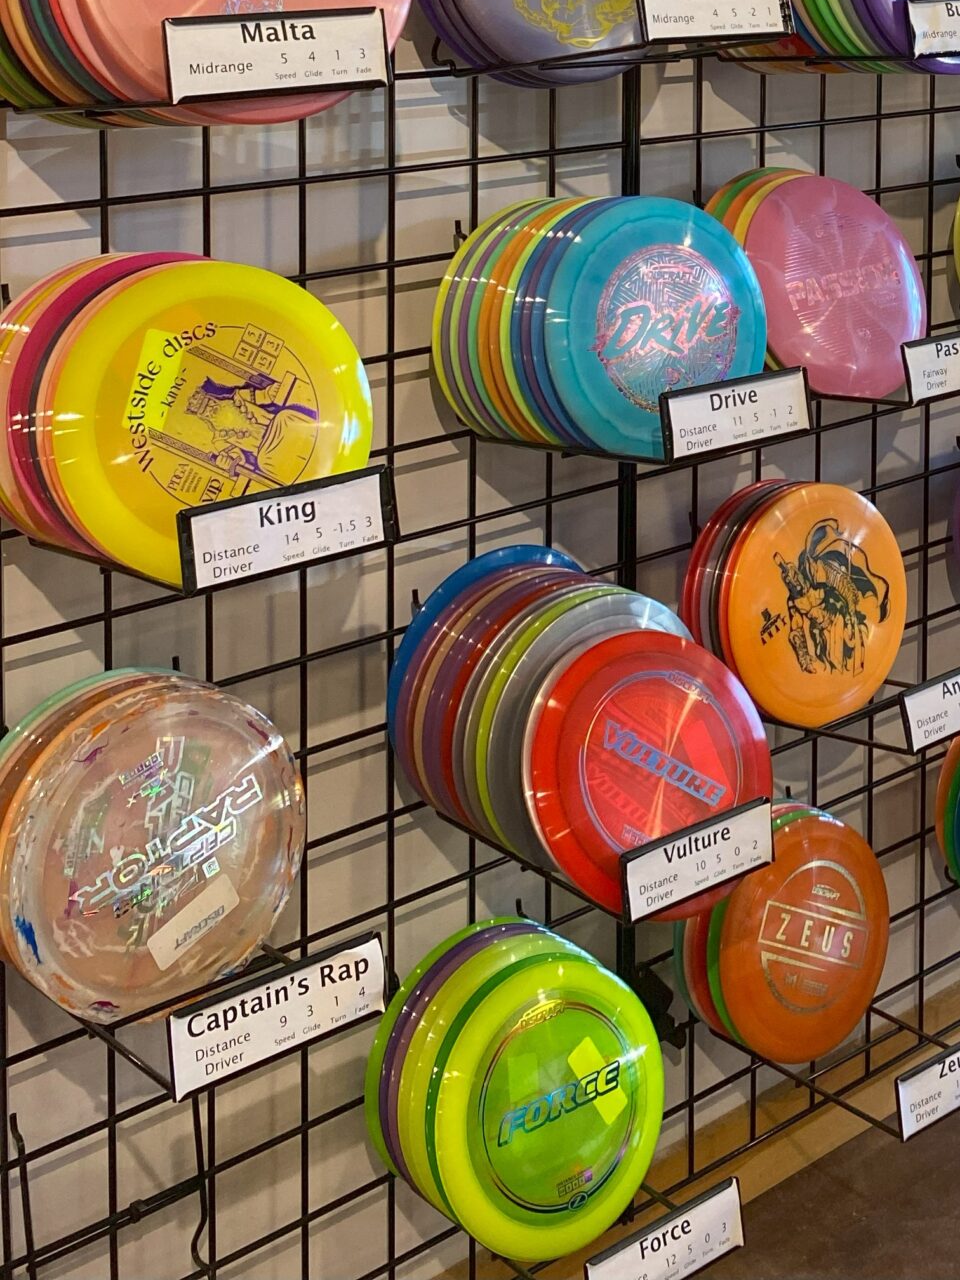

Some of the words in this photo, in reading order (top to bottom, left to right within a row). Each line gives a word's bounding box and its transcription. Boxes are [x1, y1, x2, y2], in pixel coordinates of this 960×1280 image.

[653, 15, 694, 25] Midrange
[240, 20, 316, 44] Malta
[189, 61, 253, 75] Midrange
[275, 71, 296, 81] Speed
[600, 297, 733, 360] DRIVE
[923, 367, 948, 379] Fairway
[927, 380, 947, 391] Driver
[128, 360, 162, 473] westside
[162, 322, 217, 359] discs
[710, 389, 758, 411] Drive
[679, 423, 717, 439] Distance
[686, 438, 713, 450] Driver
[202, 478, 224, 503] VIP
[259, 500, 316, 528] King
[285, 532, 299, 544] 14
[334, 521, 356, 534] -1.5
[203, 543, 260, 564] Distance
[283, 551, 305, 561] Speed
[213, 561, 253, 579] Driver
[917, 710, 948, 728] Distance
[924, 724, 946, 739] Driver
[604, 720, 727, 806] VULTURE
[664, 827, 731, 863] Vulture
[696, 861, 706, 872] 10
[639, 873, 678, 895] Distance
[646, 889, 673, 907] Driver
[776, 912, 854, 958] ZEUS
[187, 976, 310, 1039] Captain's
[319, 956, 370, 988] Rap
[274, 1032, 295, 1046] Speed
[302, 1022, 321, 1035] Glide
[330, 1013, 347, 1024] Turn
[195, 1032, 251, 1061] Distance
[205, 1051, 244, 1076] Driver
[497, 1060, 620, 1147] FORCE
[909, 1090, 942, 1113] Distance
[915, 1104, 939, 1122] Driver
[639, 1219, 692, 1260] Force
[666, 1254, 677, 1267] 12
